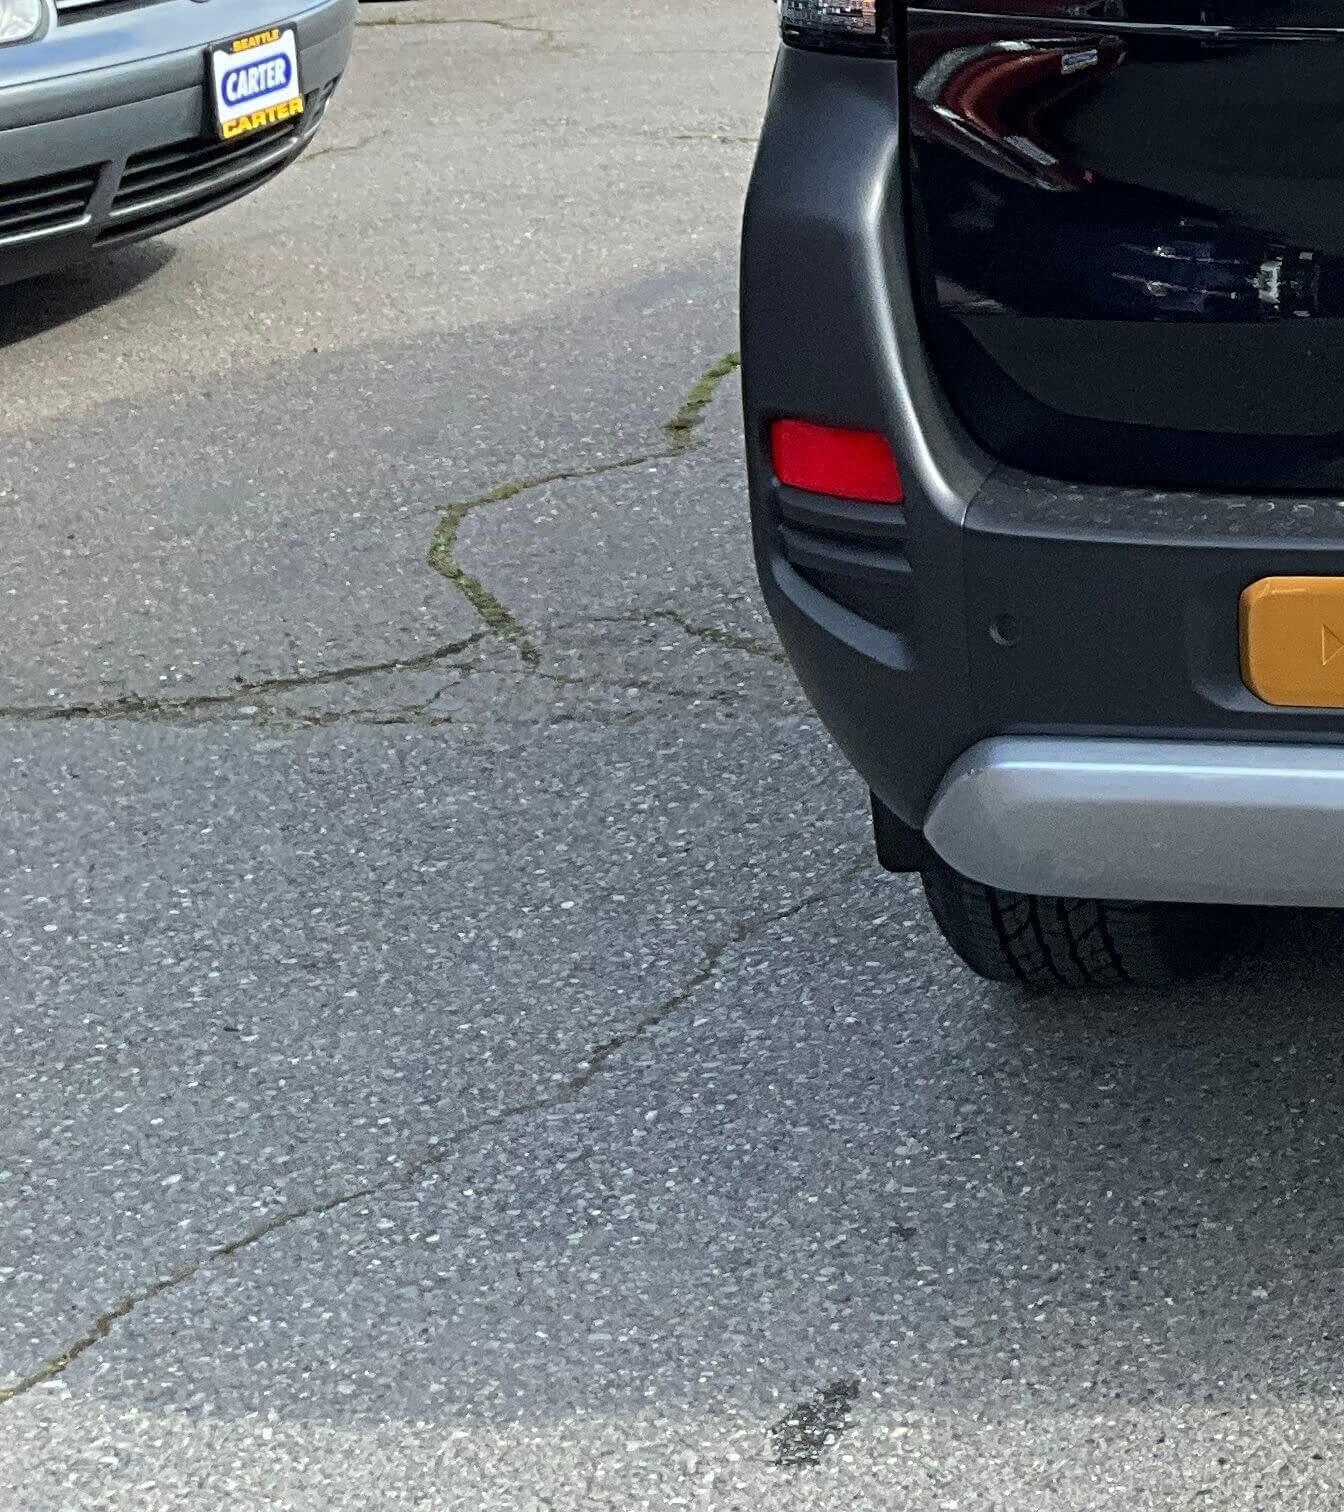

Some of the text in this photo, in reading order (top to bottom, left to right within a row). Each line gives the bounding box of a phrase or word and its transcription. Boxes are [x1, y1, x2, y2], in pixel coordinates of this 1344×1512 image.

[231, 28, 280, 52] SEATTLE
[226, 59, 287, 102] CARTER
[222, 97, 304, 139] CARTER
